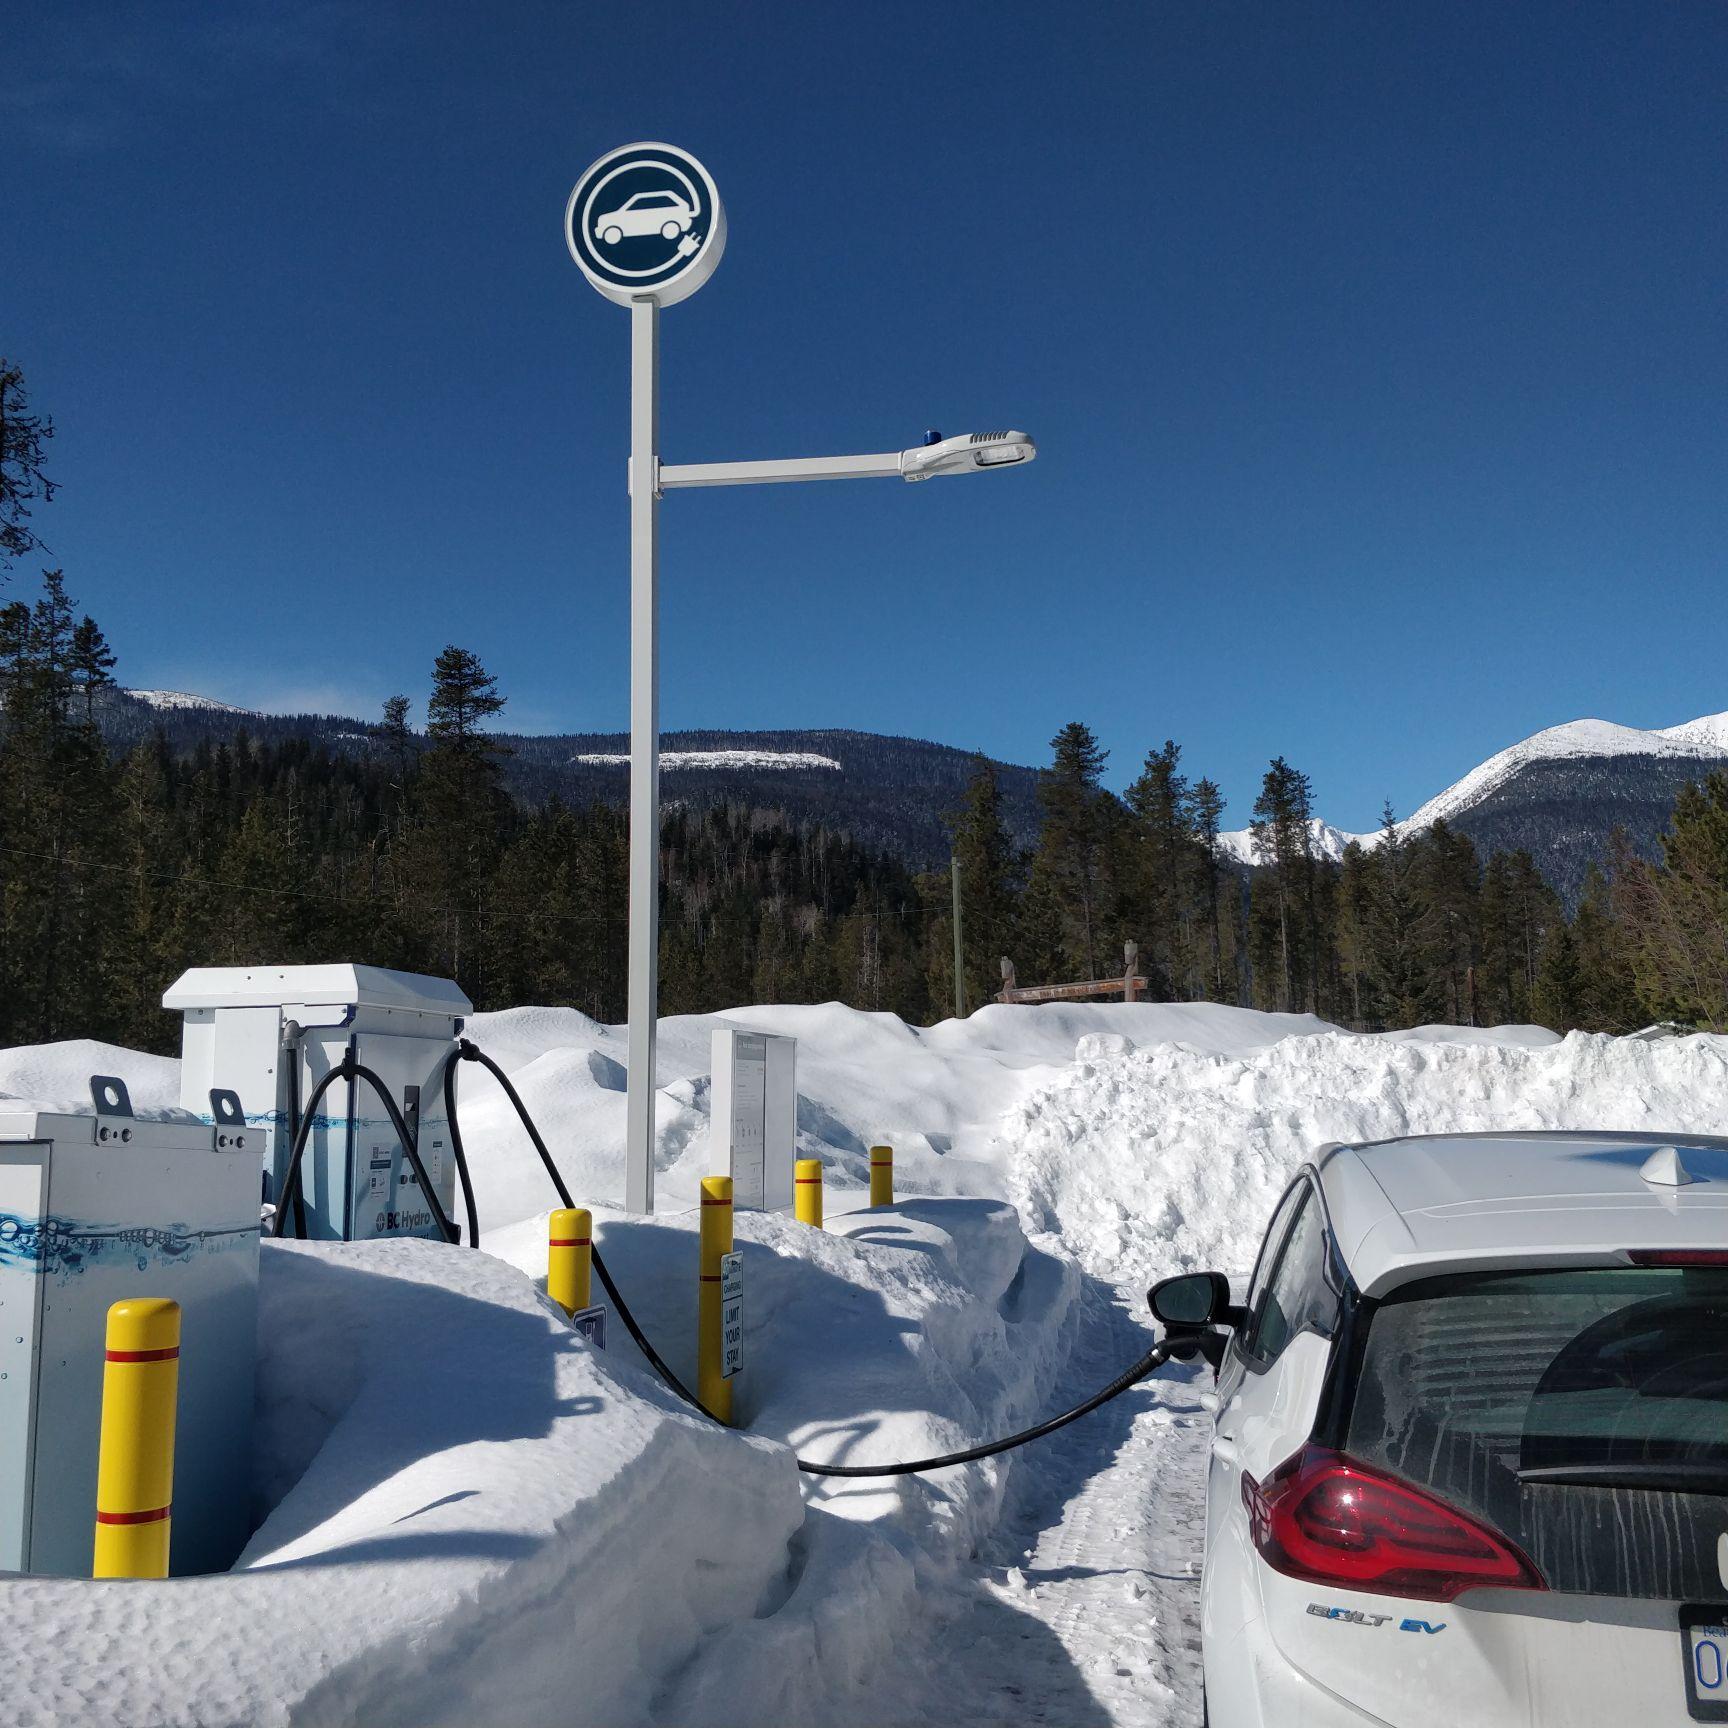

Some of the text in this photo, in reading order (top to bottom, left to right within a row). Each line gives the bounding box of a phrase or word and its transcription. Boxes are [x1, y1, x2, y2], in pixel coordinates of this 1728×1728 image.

[387, 1209, 431, 1230] BC Hydro
[726, 1306, 740, 1324] LIMIT
[726, 1327, 740, 1344] YOUR
[726, 1348, 739, 1366] STAY
[1306, 1603, 1447, 1634] BOLT EV
